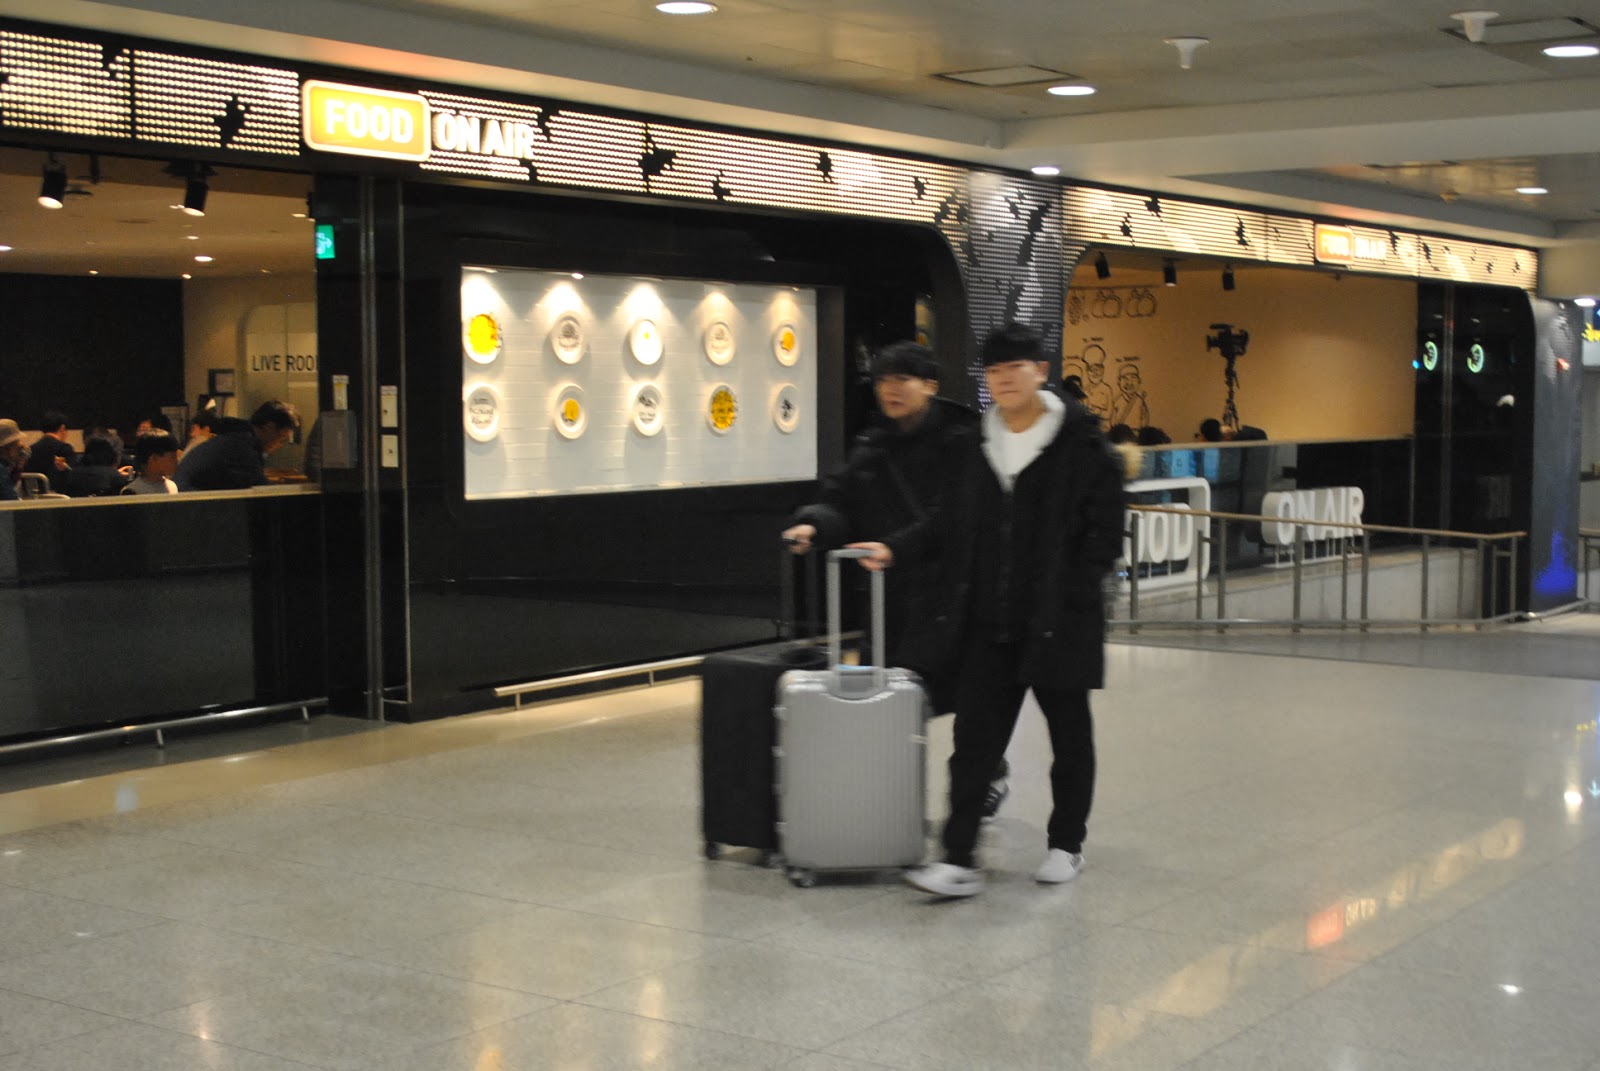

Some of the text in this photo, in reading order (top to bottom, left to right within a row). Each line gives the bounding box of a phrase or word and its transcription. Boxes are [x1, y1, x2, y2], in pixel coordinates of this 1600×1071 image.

[325, 98, 534, 159] FOOD ON AIR
[252, 355, 317, 371] LIVE ROO
[1122, 486, 1364, 566] OOD ON AIR
